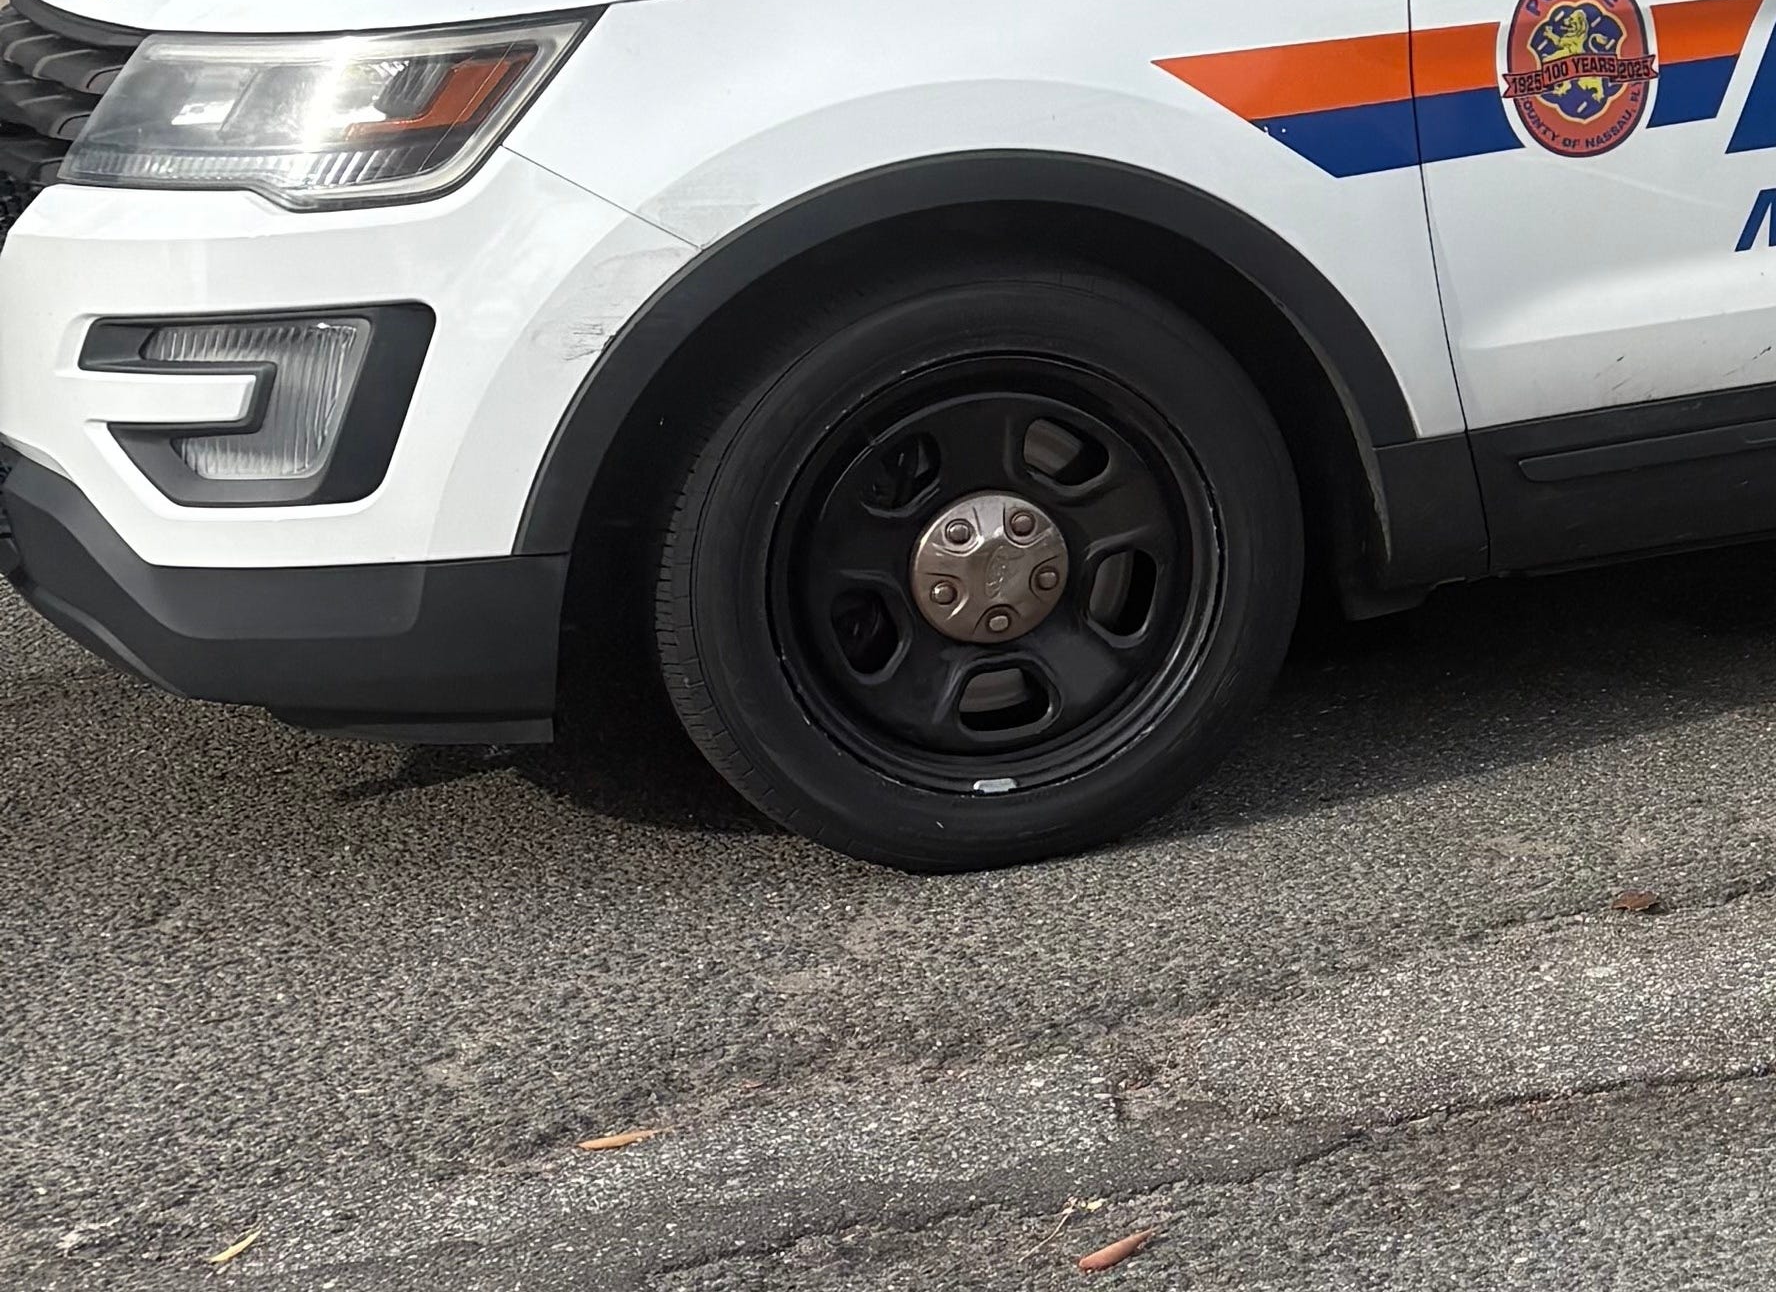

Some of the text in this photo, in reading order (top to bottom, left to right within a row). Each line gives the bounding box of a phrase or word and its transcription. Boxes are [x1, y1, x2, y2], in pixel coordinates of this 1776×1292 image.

[1511, 55, 1651, 95] 1925 100 YEARS 2025
[1520, 97, 1561, 142] OUNTY
[1561, 138, 1581, 149] OF
